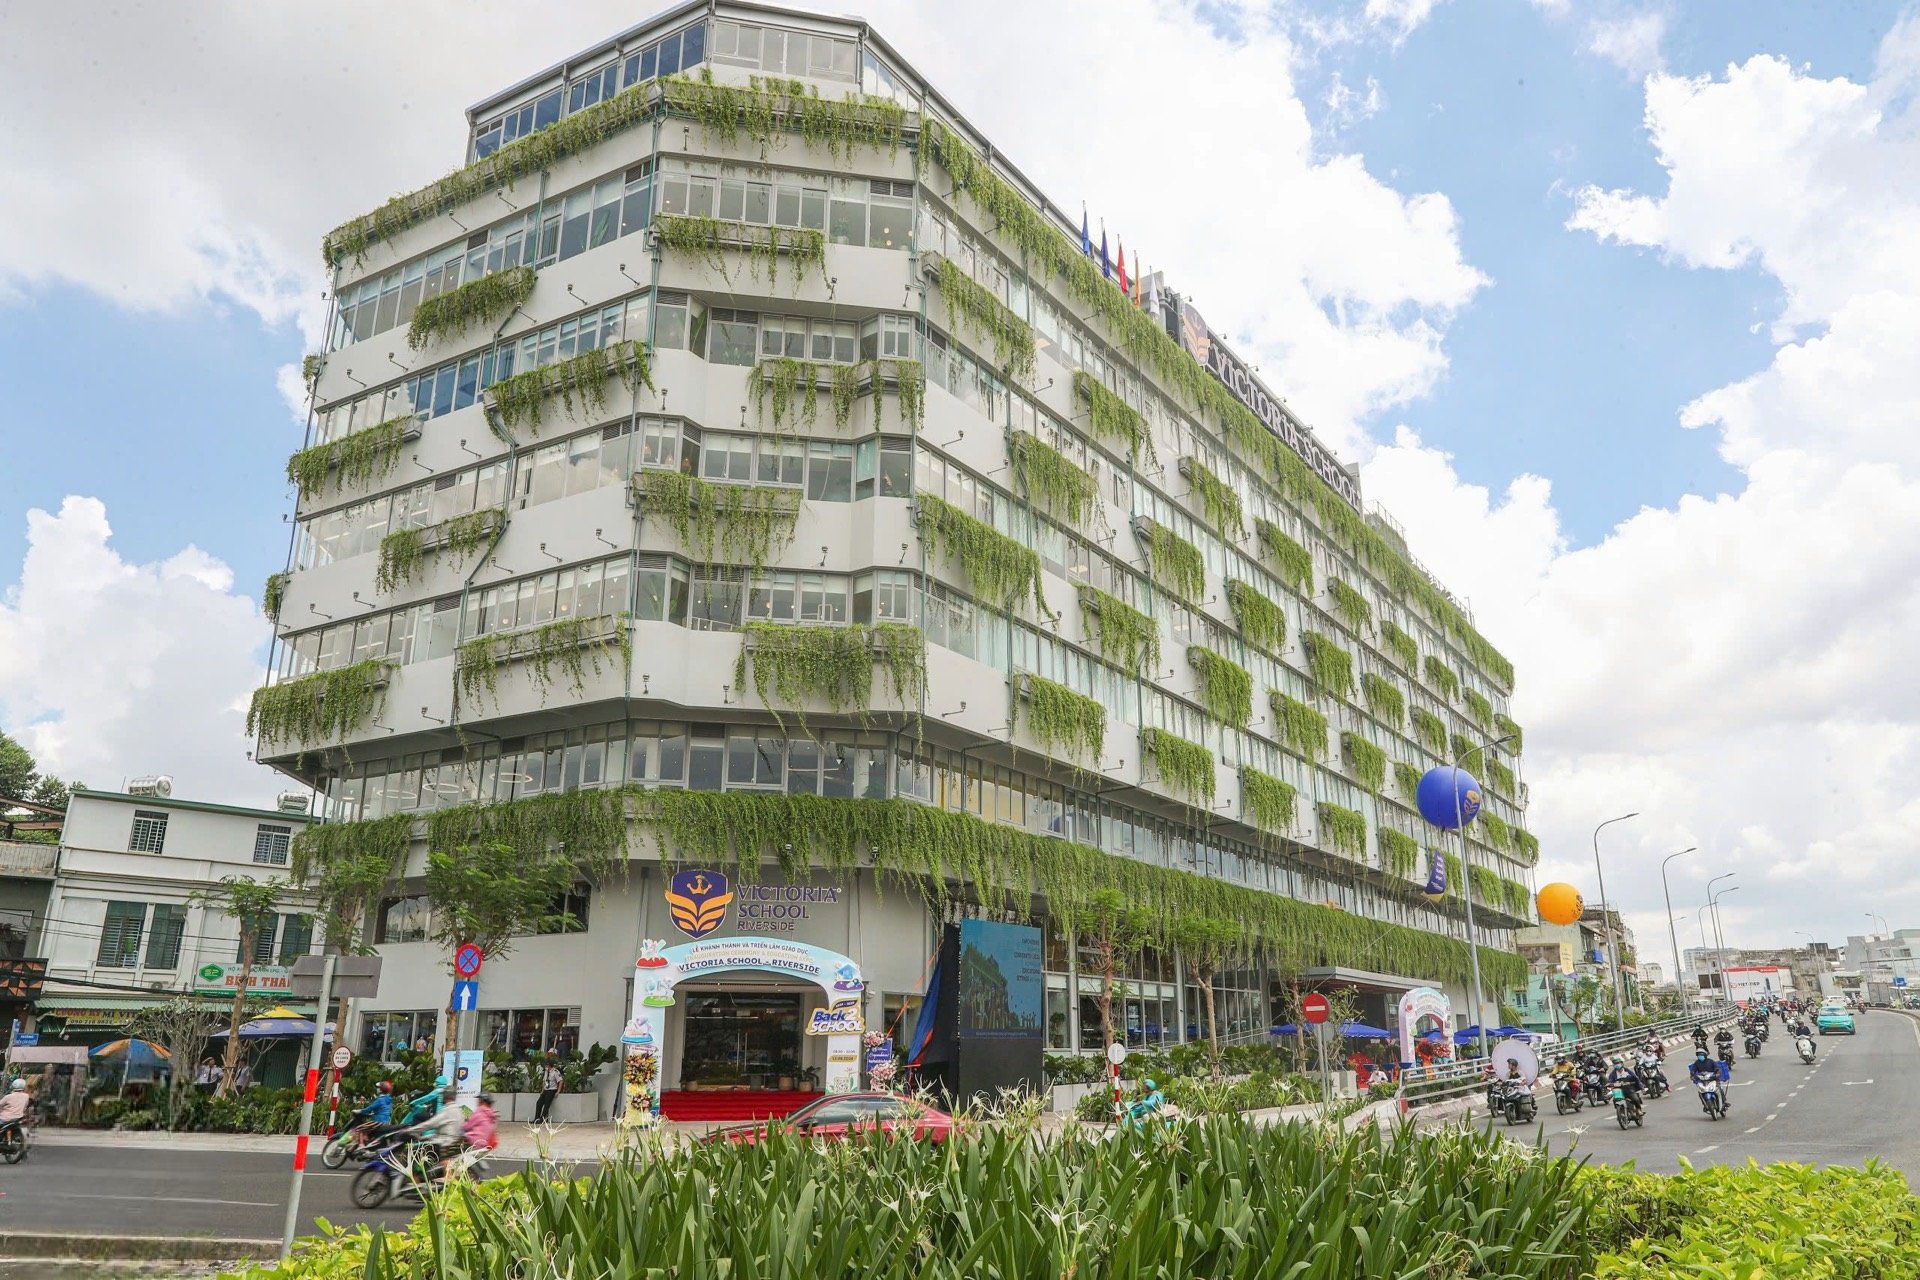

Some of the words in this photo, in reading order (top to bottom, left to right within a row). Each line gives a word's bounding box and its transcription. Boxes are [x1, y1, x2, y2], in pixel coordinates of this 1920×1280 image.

[1209, 343, 1305, 458] VICTORIA
[736, 884, 838, 903] VICTORIA
[738, 903, 810, 919] SCHOOL
[738, 921, 794, 931] RIVERSIDE
[679, 958, 724, 972] VICTORIA
[727, 957, 763, 966] SCHOOL
[772, 959, 820, 974] RIVERSIDE
[814, 1010, 846, 1021] Back
[810, 1020, 862, 1032] SCHOOL
